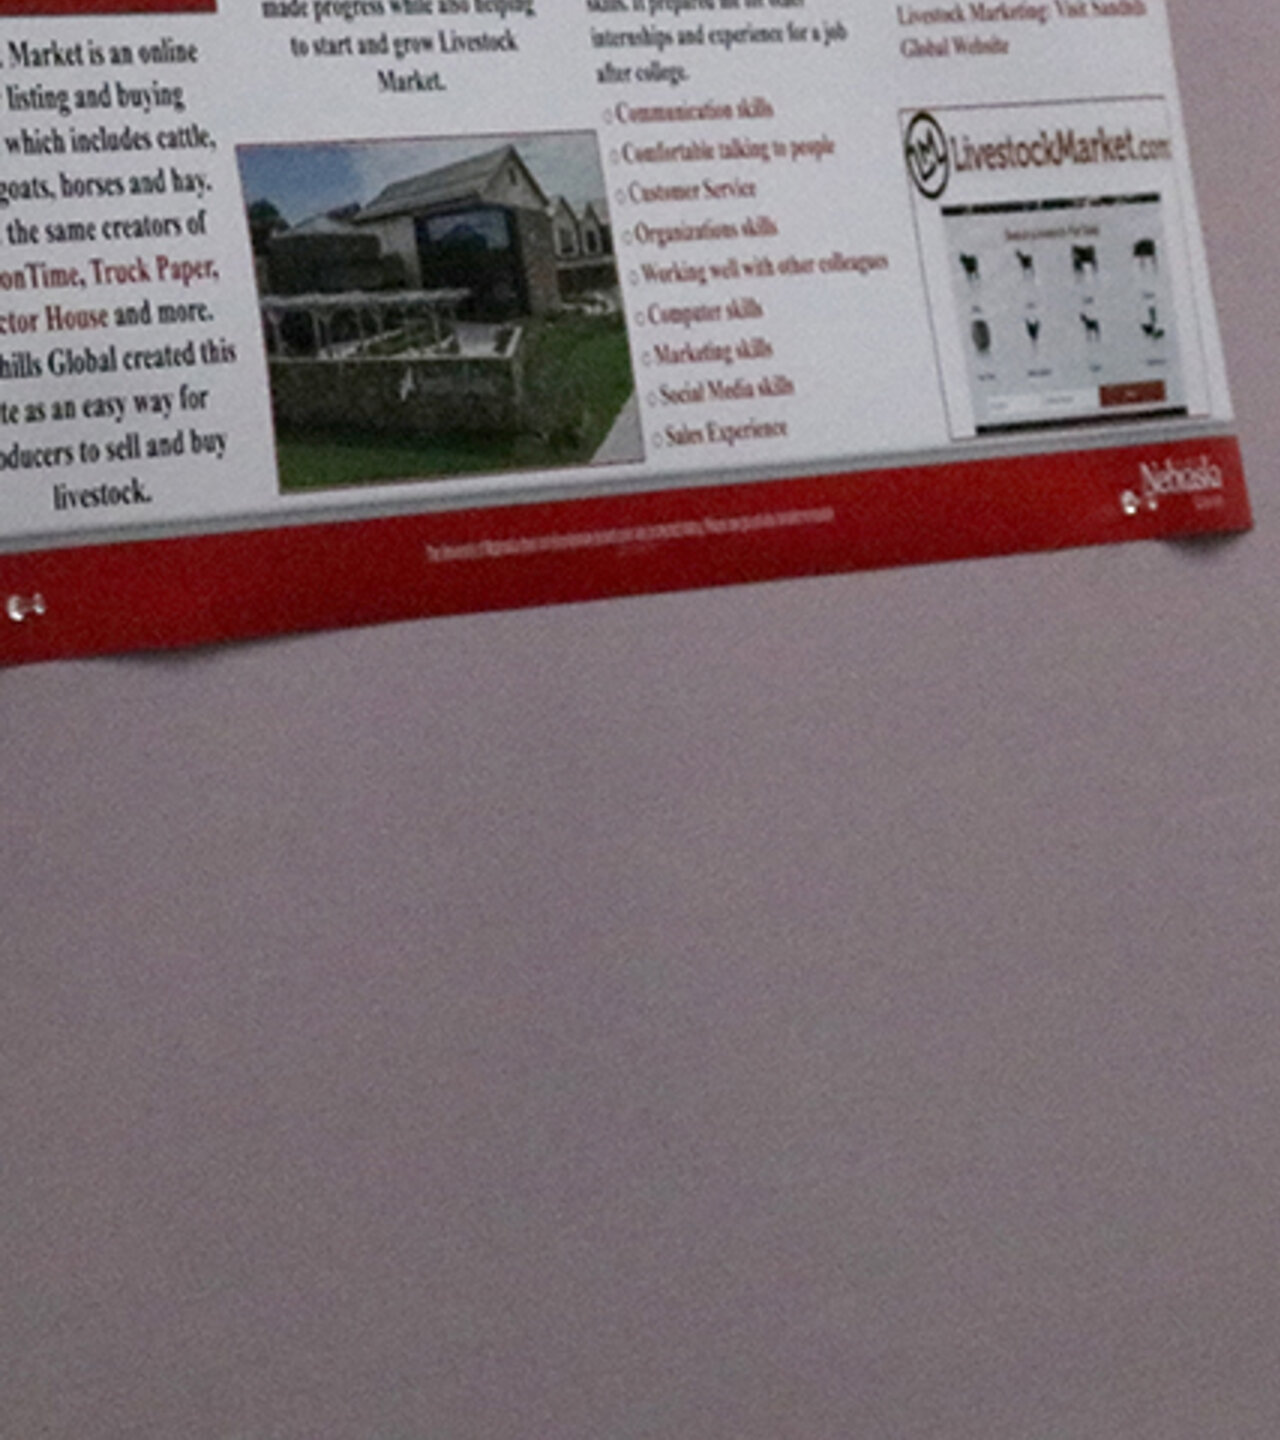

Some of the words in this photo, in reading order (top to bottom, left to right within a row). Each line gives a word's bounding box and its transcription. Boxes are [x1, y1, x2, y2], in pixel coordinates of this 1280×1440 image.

[313, 0, 385, 23] progress
[8, 40, 84, 68] Market
[88, 38, 105, 66] is
[109, 45, 134, 65] an
[138, 35, 198, 65] online
[290, 35, 309, 57] to
[313, 35, 353, 56] start
[358, 31, 389, 55] and
[393, 34, 434, 60] grow
[438, 29, 519, 54] Livestock
[5, 82, 71, 116] listing
[74, 80, 112, 109] and
[115, 79, 187, 114] buying
[377, 69, 446, 93] Market.
[5, 127, 66, 156] which
[70, 125, 152, 152] includes
[156, 122, 217, 151] cattle,
[951, 126, 1171, 172] LivestockMarket.com
[59, 170, 124, 198] horses
[129, 166, 166, 196] and
[171, 166, 213, 199] hay.
[6, 218, 40, 247] the
[45, 221, 97, 244] same
[101, 215, 182, 242] creators
[186, 209, 207, 235] of
[88, 256, 151, 286] Truck
[155, 254, 220, 288] Paper,
[44, 304, 109, 332] House
[113, 299, 152, 327] and
[157, 301, 214, 324] more.
[47, 344, 119, 378] Global
[122, 341, 196, 372] created
[200, 337, 237, 364] this
[24, 403, 46, 424] as
[51, 400, 77, 422] an
[82, 398, 127, 424] easy
[134, 393, 173, 421] way
[179, 383, 209, 411] for
[79, 441, 100, 463] to
[105, 430, 141, 461] sell
[146, 428, 186, 458] and
[190, 426, 228, 460] buy
[664, 424, 704, 447] Sales
[707, 417, 788, 446] Experience
[53, 477, 153, 511] livestock.
